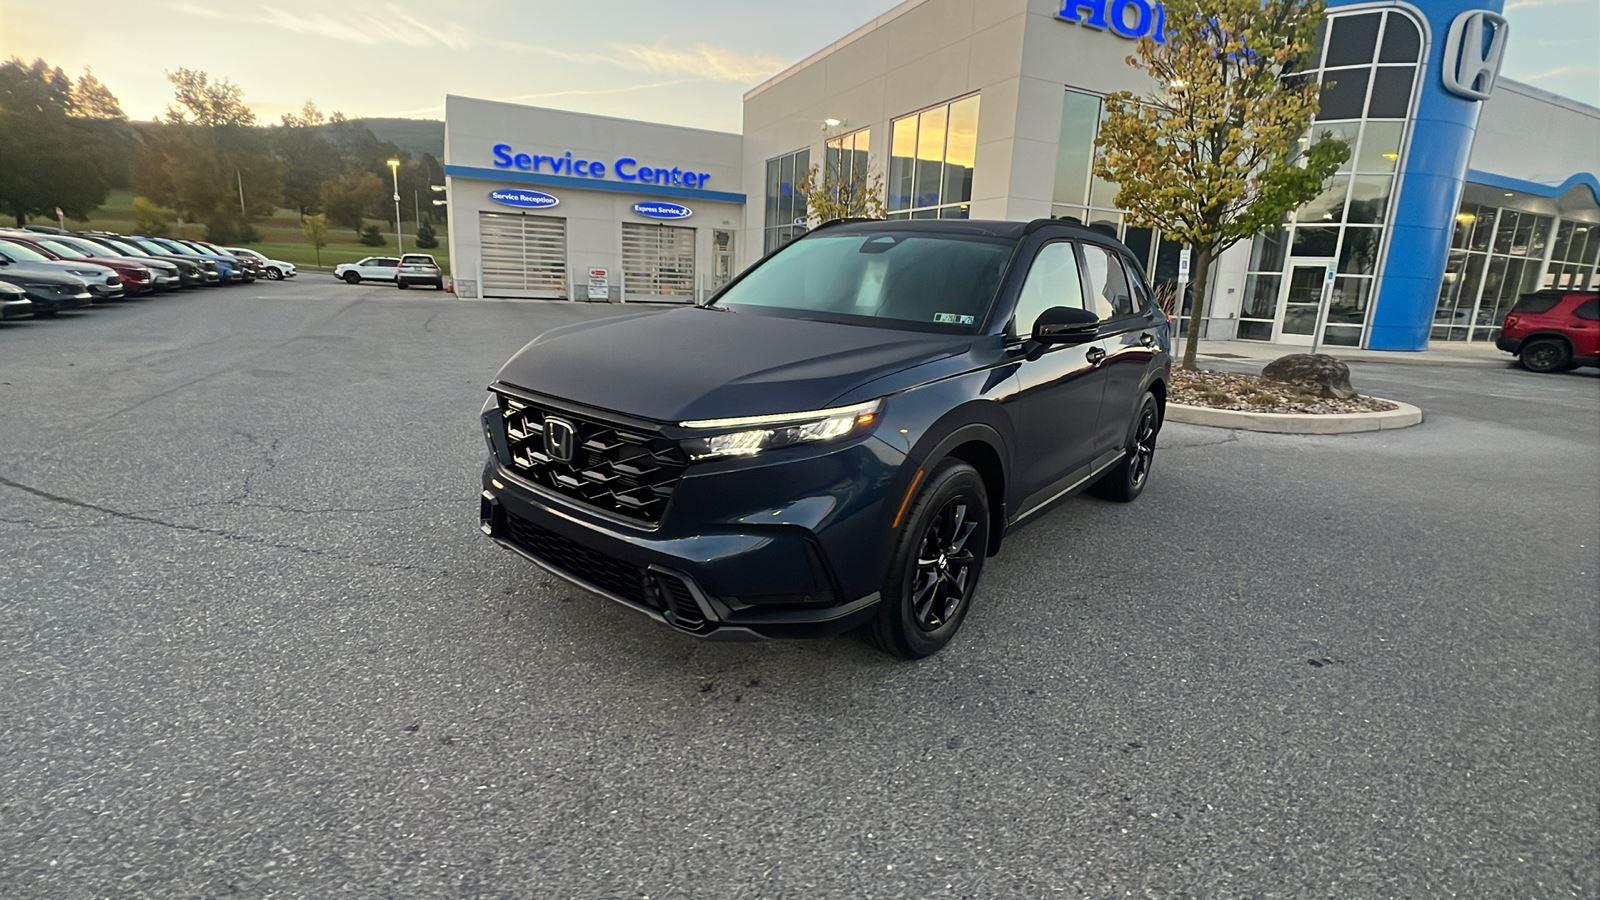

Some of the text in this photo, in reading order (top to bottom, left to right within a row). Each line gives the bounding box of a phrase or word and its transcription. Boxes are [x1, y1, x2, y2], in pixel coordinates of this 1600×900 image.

[492, 143, 711, 188] Service Center
[492, 192, 554, 204] Service Reception
[634, 204, 680, 214] Express Service
